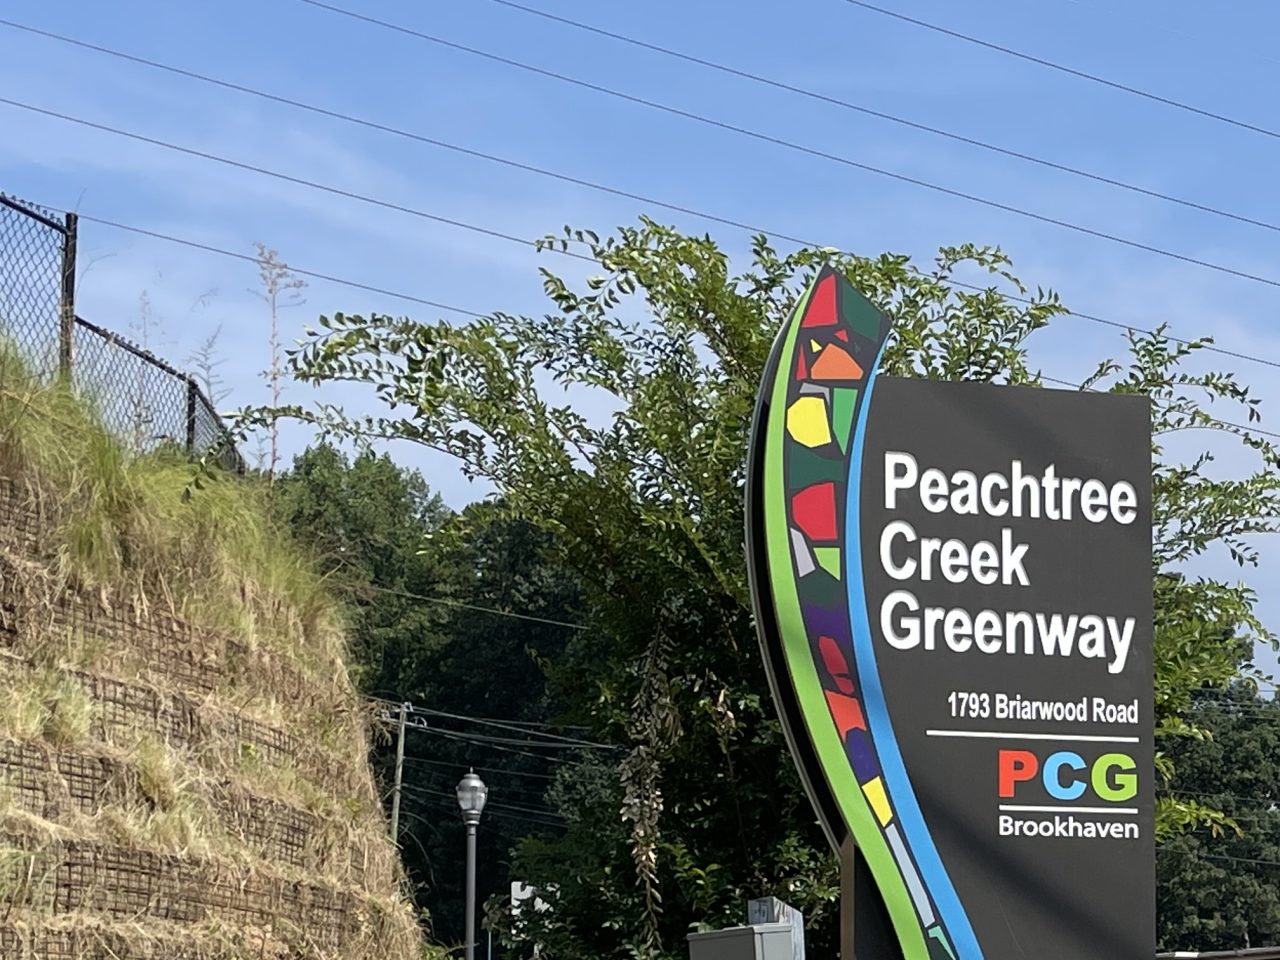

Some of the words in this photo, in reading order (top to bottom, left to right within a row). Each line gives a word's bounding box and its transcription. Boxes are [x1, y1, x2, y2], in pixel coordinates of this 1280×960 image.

[883, 450, 1138, 524] Peachtree
[880, 520, 1030, 586] Creek
[880, 590, 1136, 675] Greenway
[948, 691, 990, 718] 1793
[995, 693, 1087, 722] Briarwood
[1092, 697, 1139, 724] Road
[998, 749, 1138, 802] PCG
[999, 815, 1139, 838] Brookhaven
